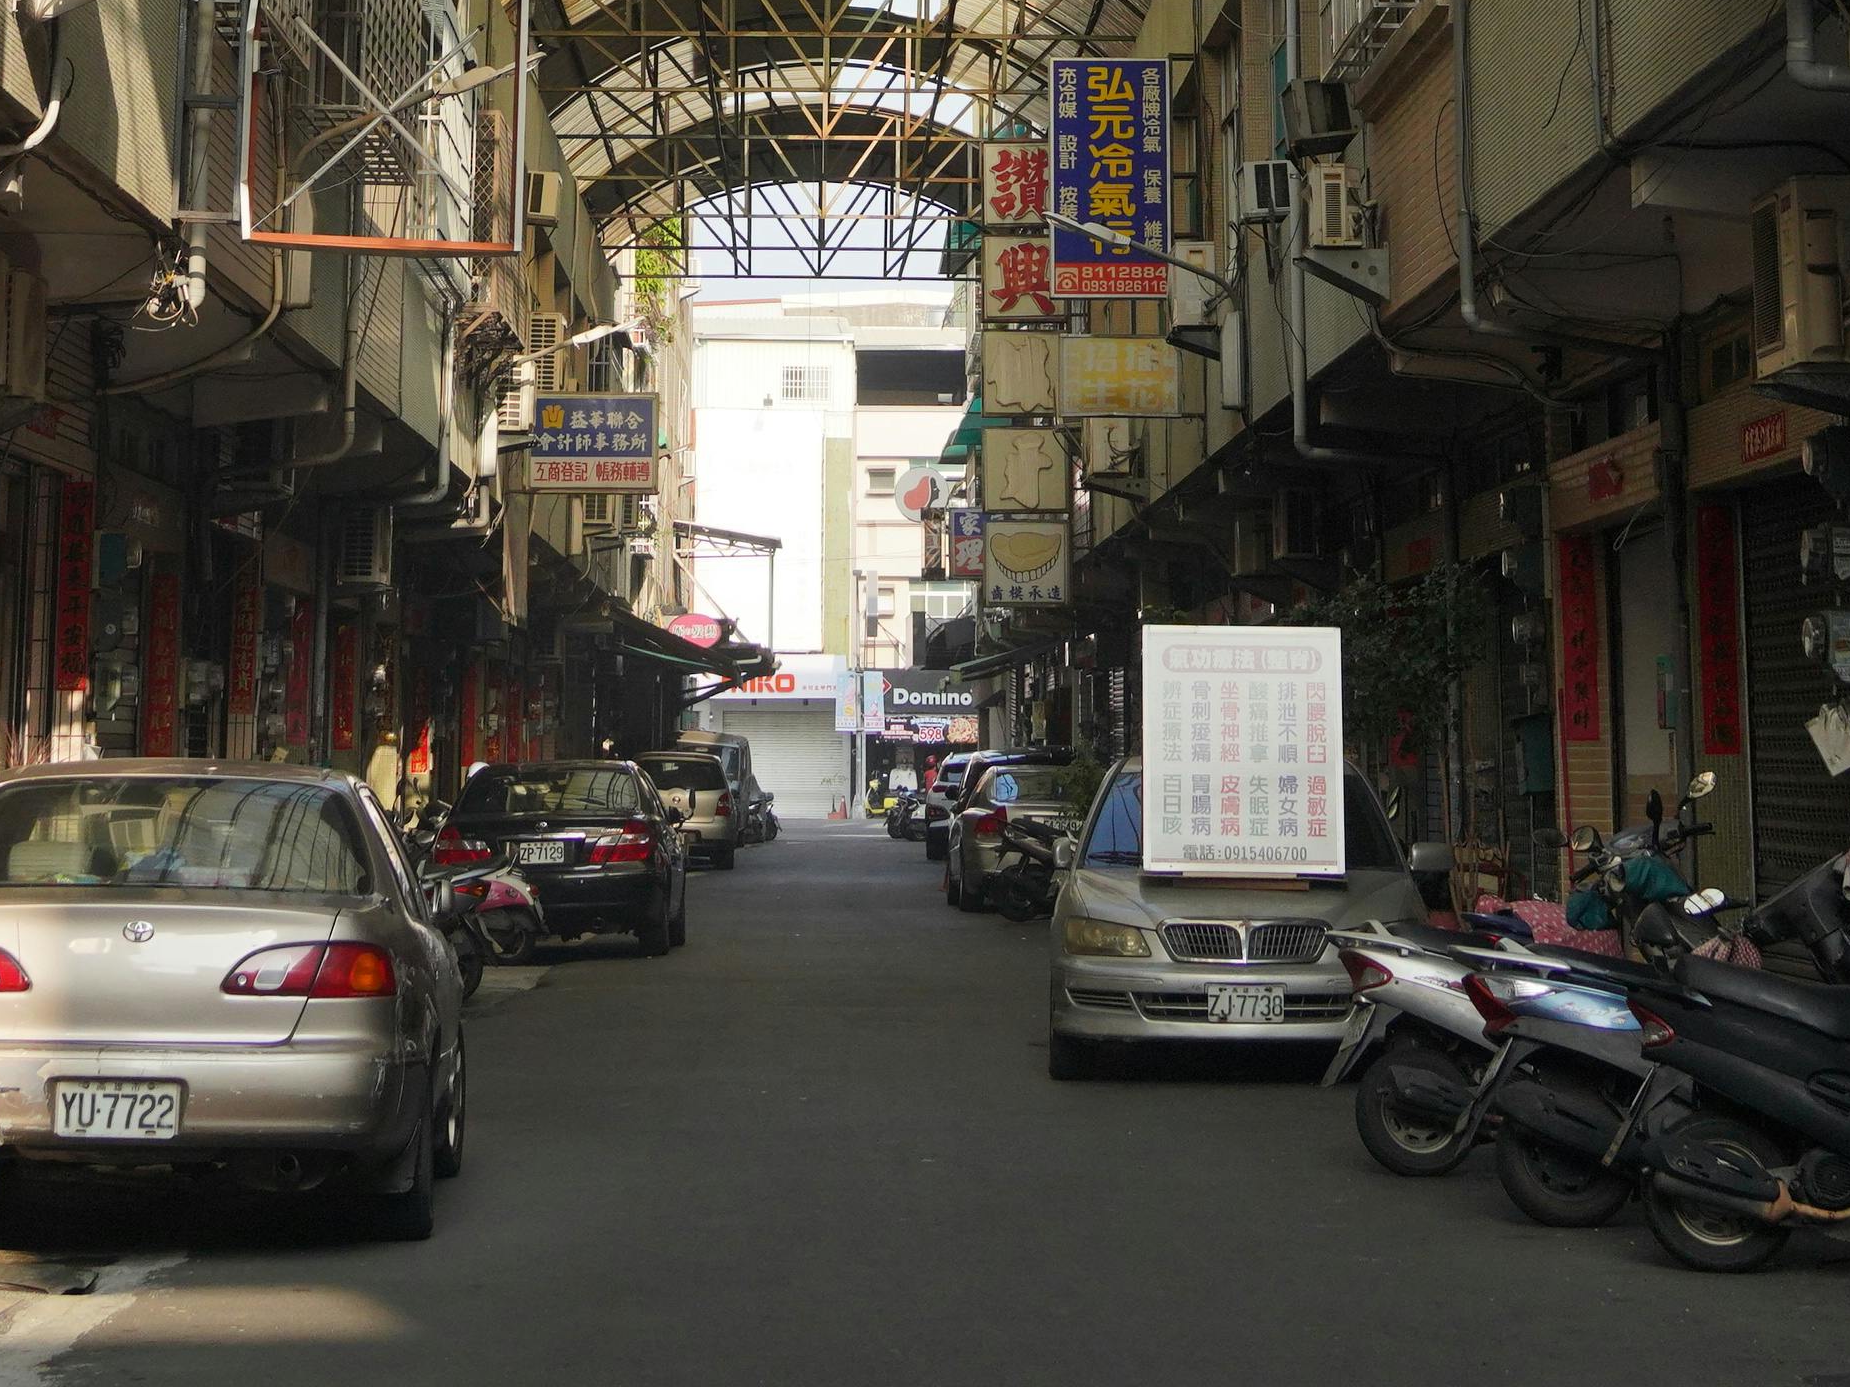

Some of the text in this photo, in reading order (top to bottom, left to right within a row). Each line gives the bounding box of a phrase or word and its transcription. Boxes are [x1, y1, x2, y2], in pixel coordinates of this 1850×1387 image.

[1058, 135, 1078, 170] 設計
[1081, 266, 1167, 278] 8112884
[1081, 280, 1167, 293] 0931926116
[569, 410, 645, 430] 益華聯合
[537, 432, 647, 452] 會計師事務所
[991, 585, 1062, 601] 齒模承造
[920, 728, 943, 741] 598
[1163, 774, 1182, 835] 百日咳
[1192, 774, 1211, 836] 胃腸病
[1221, 775, 1240, 837] 皮膚病
[1250, 775, 1269, 837] 失眠症
[1279, 775, 1297, 838] 婦女病
[1307, 776, 1326, 838] 過敏症
